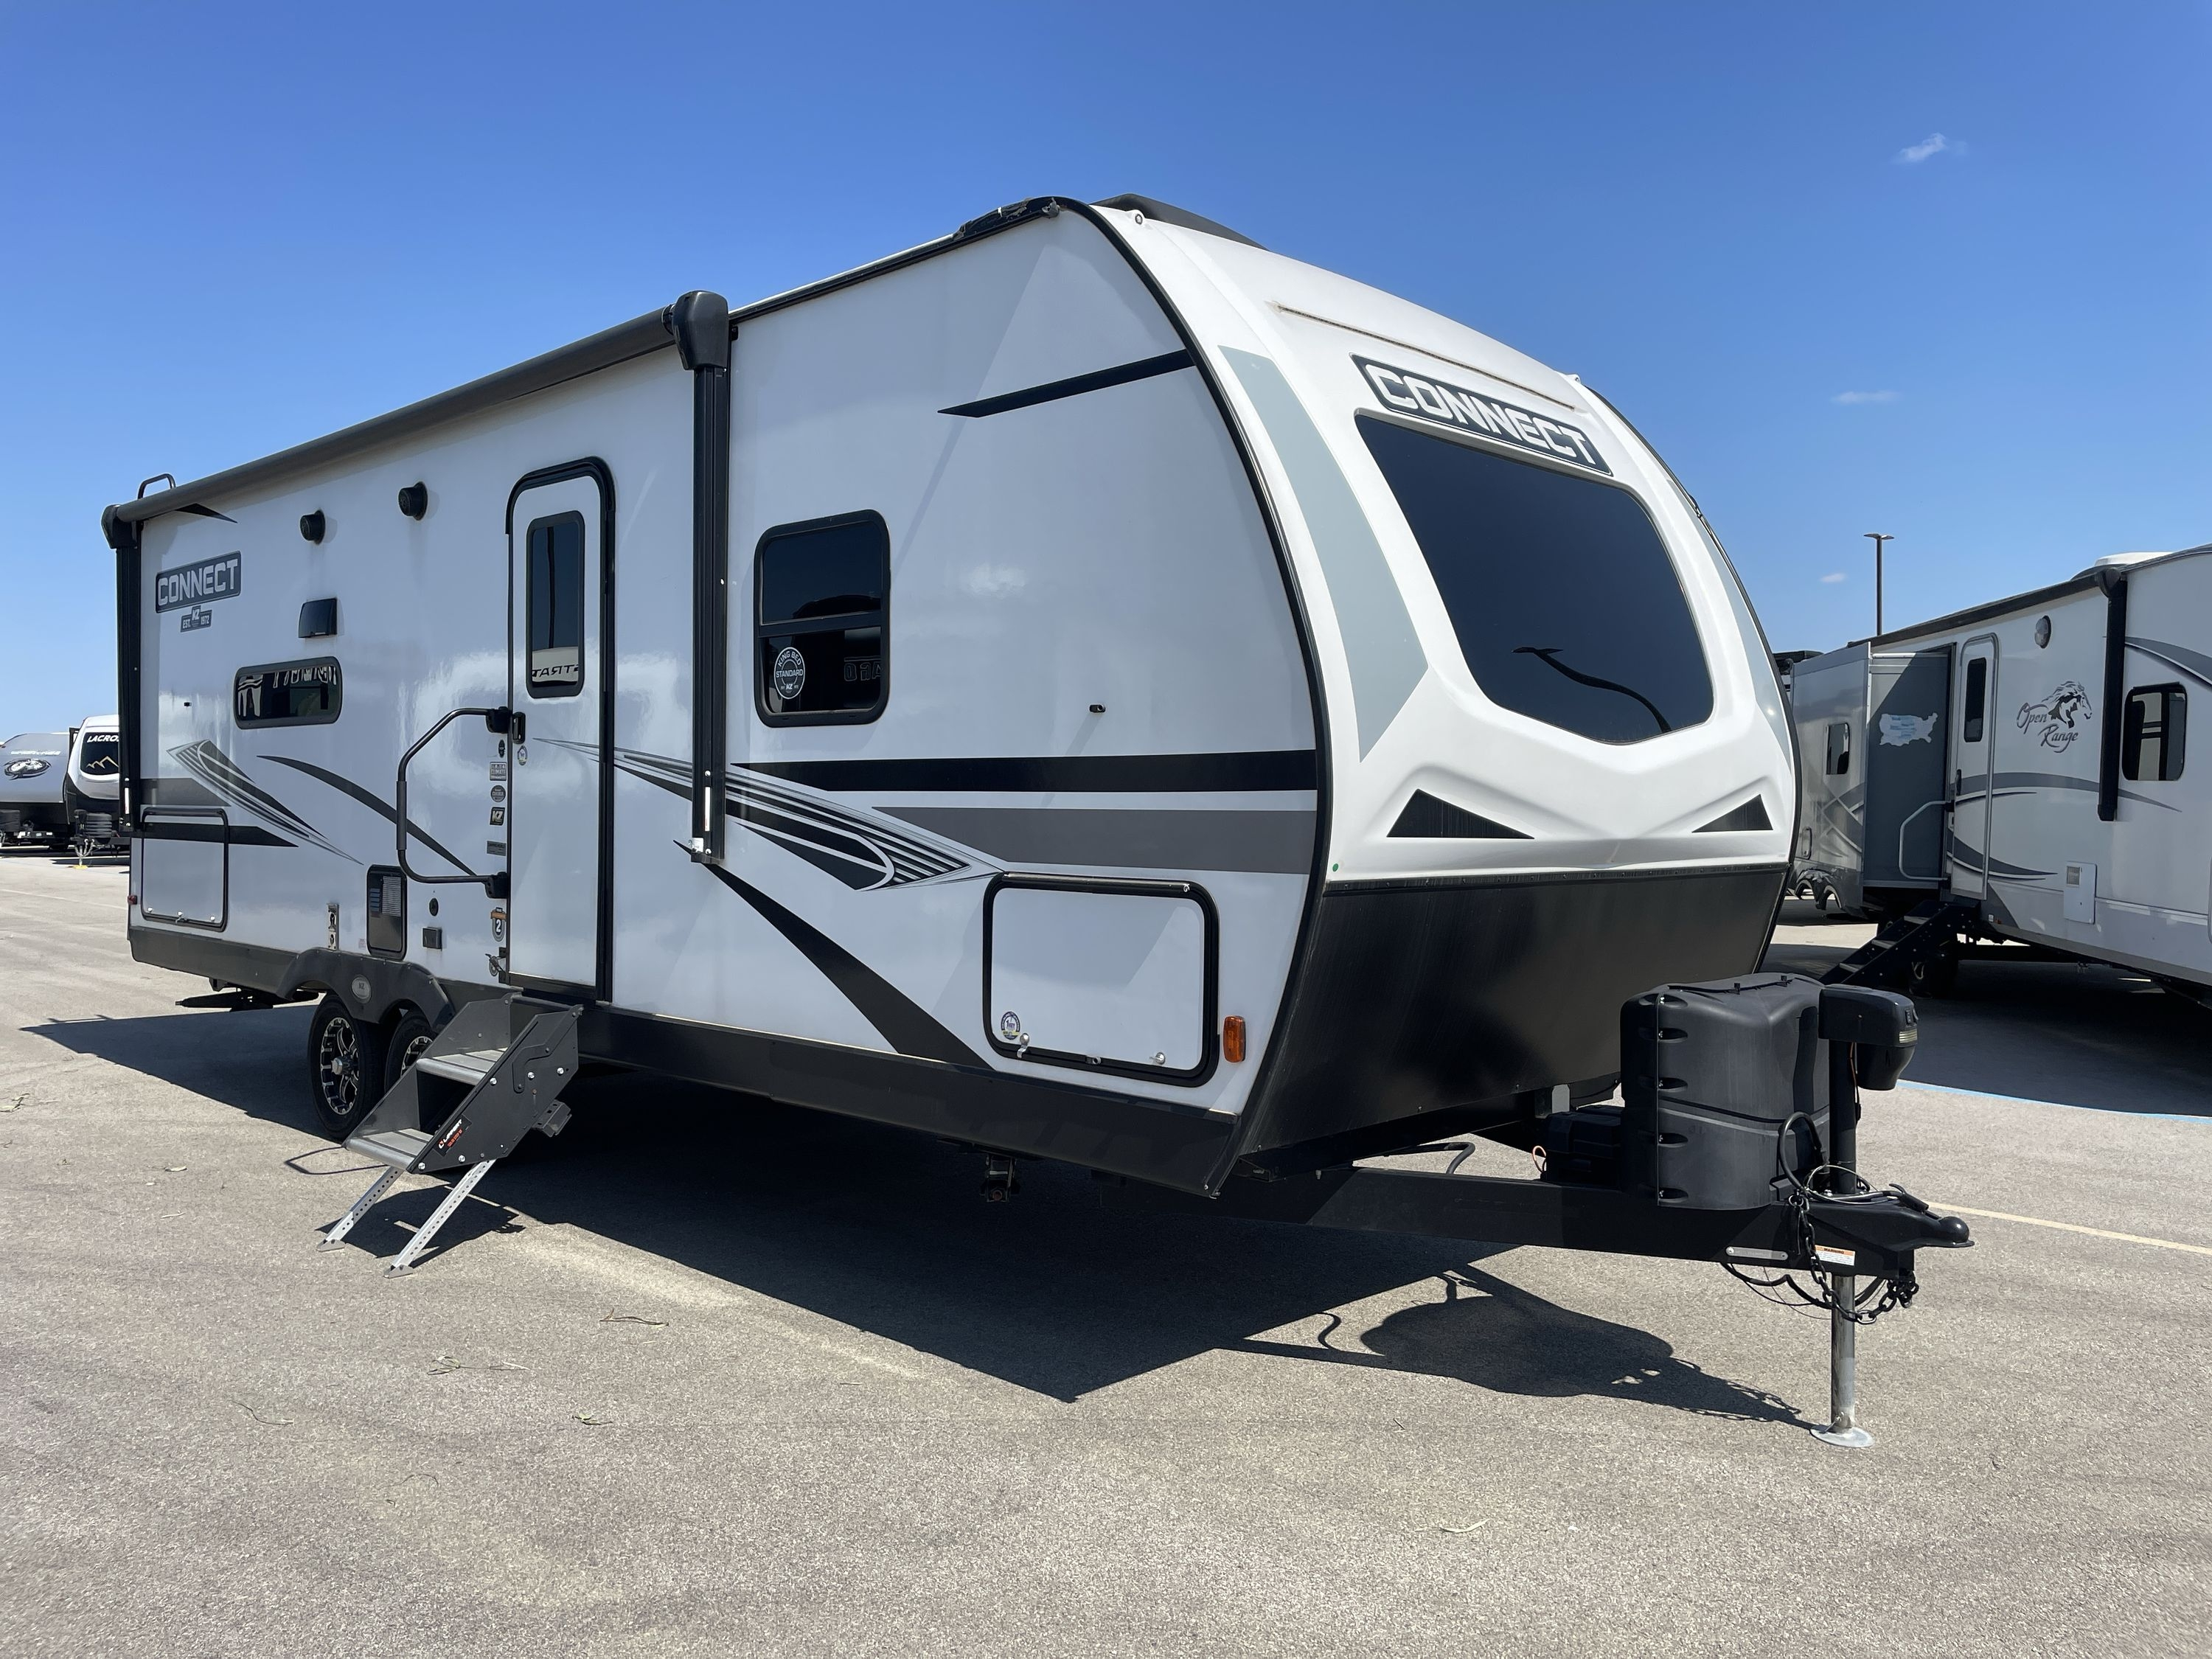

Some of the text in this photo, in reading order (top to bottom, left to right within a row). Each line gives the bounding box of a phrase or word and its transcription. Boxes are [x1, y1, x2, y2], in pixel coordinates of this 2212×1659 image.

[1365, 364, 1596, 465] CONNECT
[157, 558, 238, 606] CONNECT
[778, 650, 801, 667] KING BED
[776, 669, 804, 678] STANDARD
[2017, 702, 2049, 734] Open
[2037, 723, 2079, 754] Range
[492, 810, 504, 822] KZ
[495, 919, 501, 933] 2
